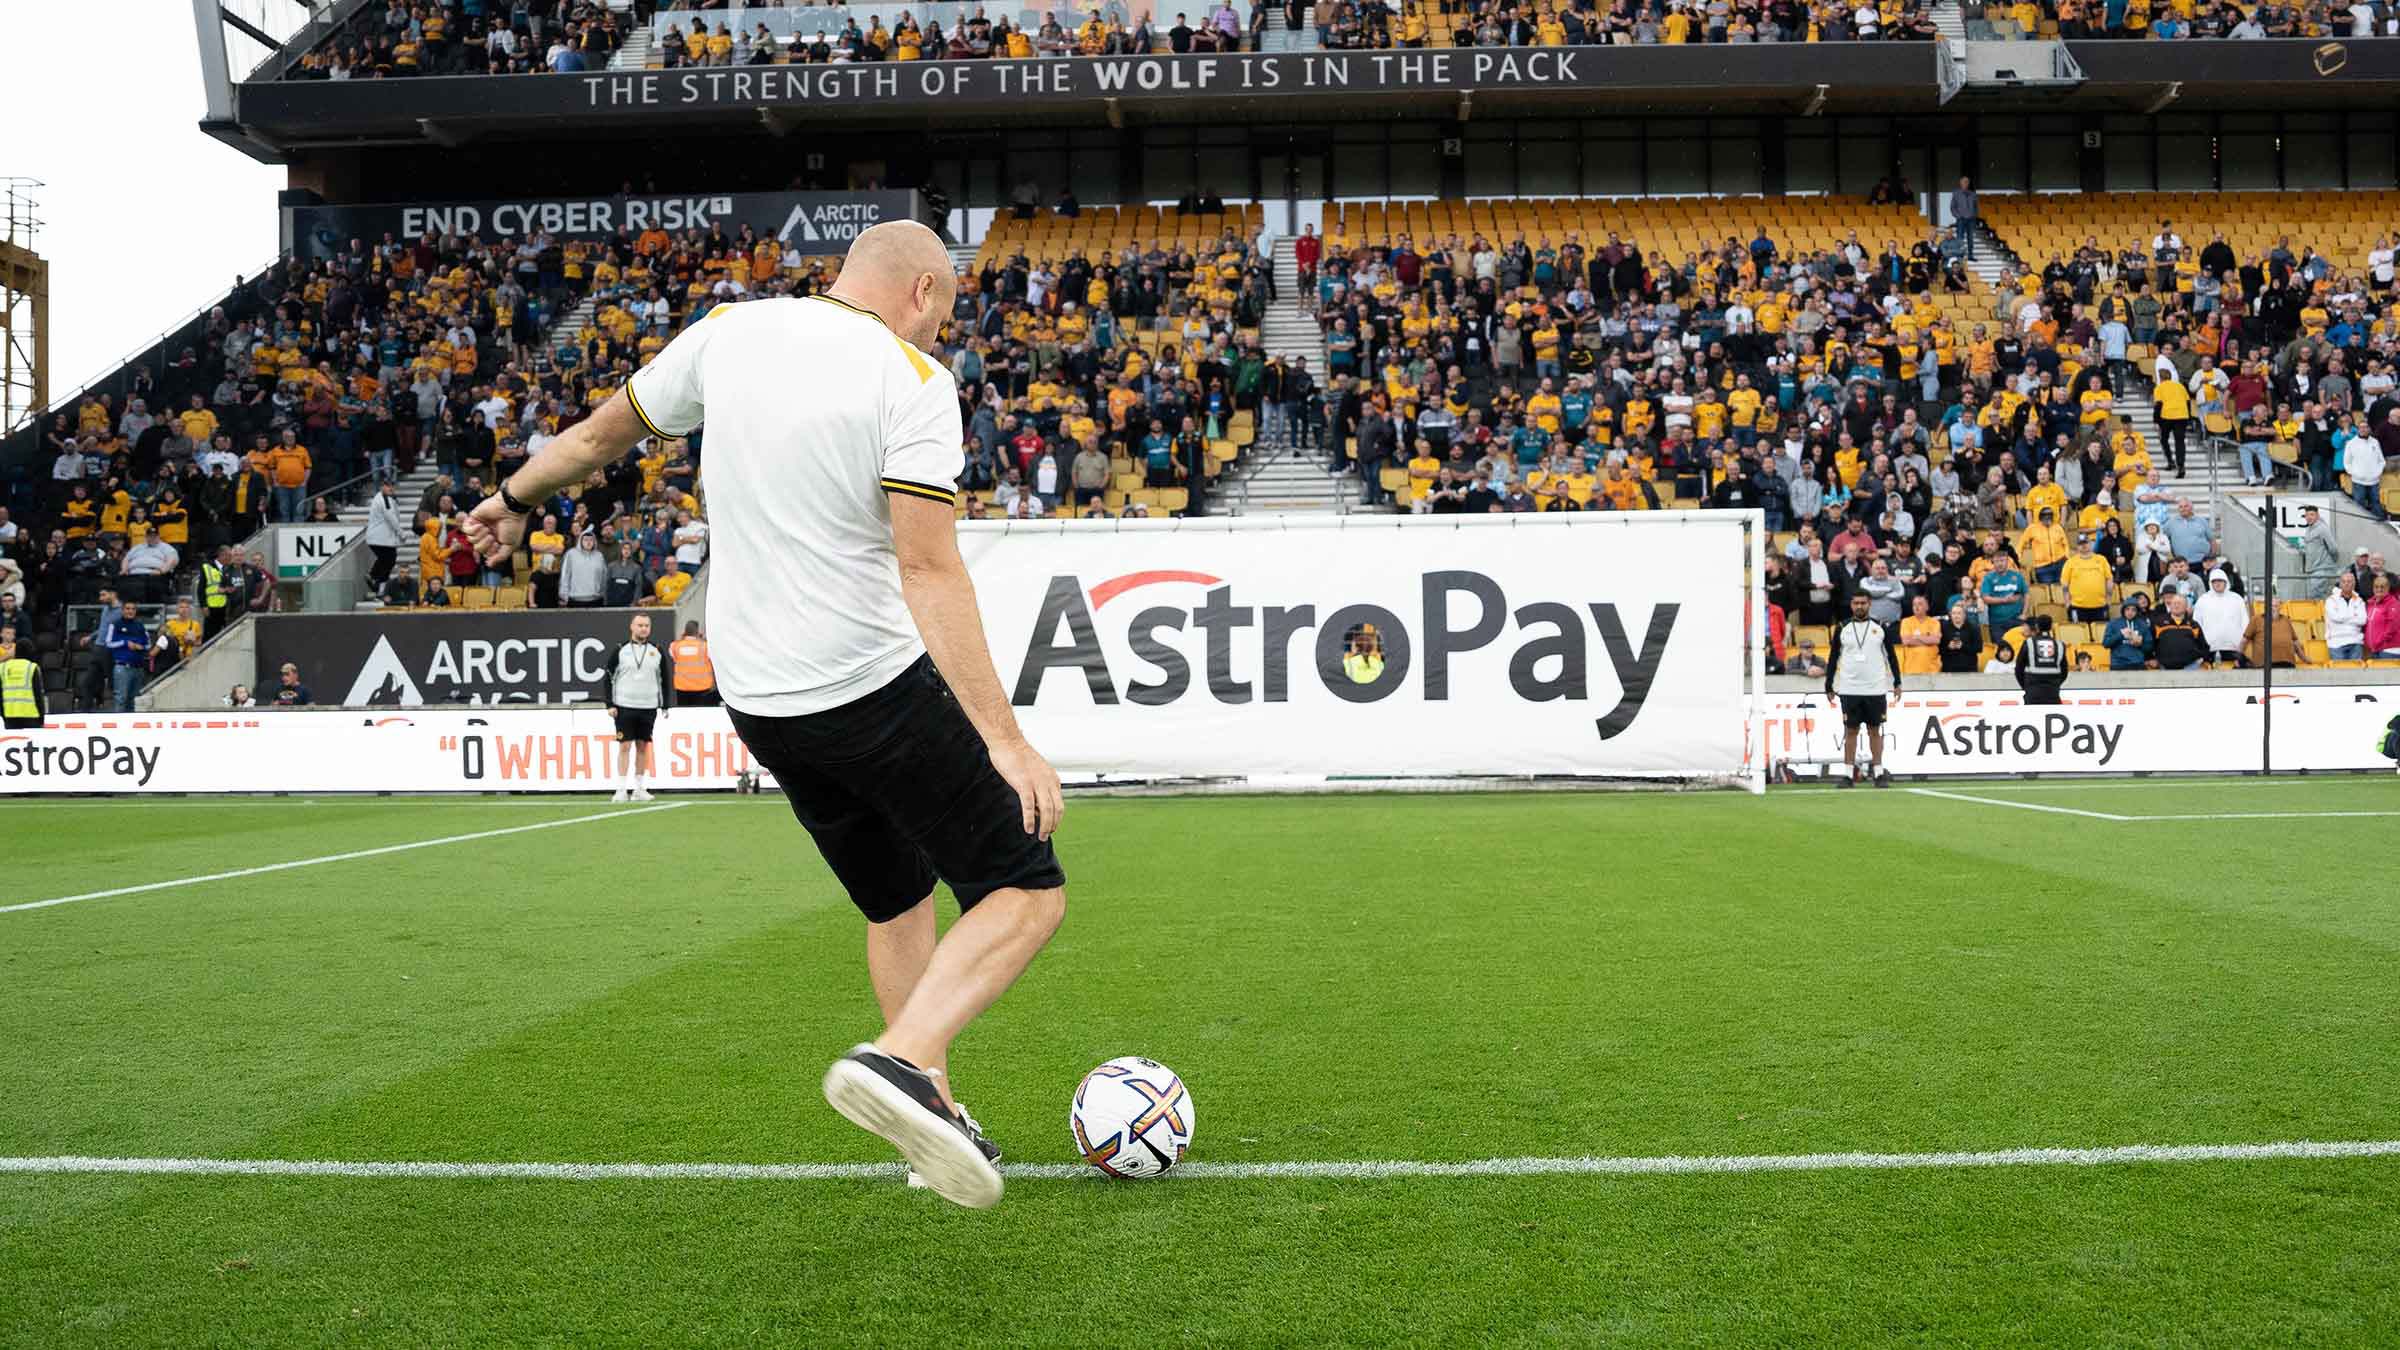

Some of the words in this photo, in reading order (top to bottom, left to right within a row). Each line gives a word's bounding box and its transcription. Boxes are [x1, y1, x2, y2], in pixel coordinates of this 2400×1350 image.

[584, 76, 659, 105] THE
[681, 68, 898, 102] STRENGTH
[920, 66, 971, 95] OF
[992, 63, 1071, 93] THE
[1092, 60, 1217, 90] WOLF
[1241, 58, 1281, 87] IS
[1303, 57, 1349, 85] IN
[1371, 54, 1451, 84] THE
[1474, 52, 1578, 82] PACK
[403, 206, 481, 239] END
[493, 201, 613, 235] CYBER
[813, 204, 880, 222] ARCTIC
[425, 637, 606, 684] ARCTIC
[1011, 570, 1681, 741] AstroPay
[0, 736, 161, 787] stroPay
[495, 735, 617, 780] WHAT
[1917, 713, 2125, 766] AstroPay
